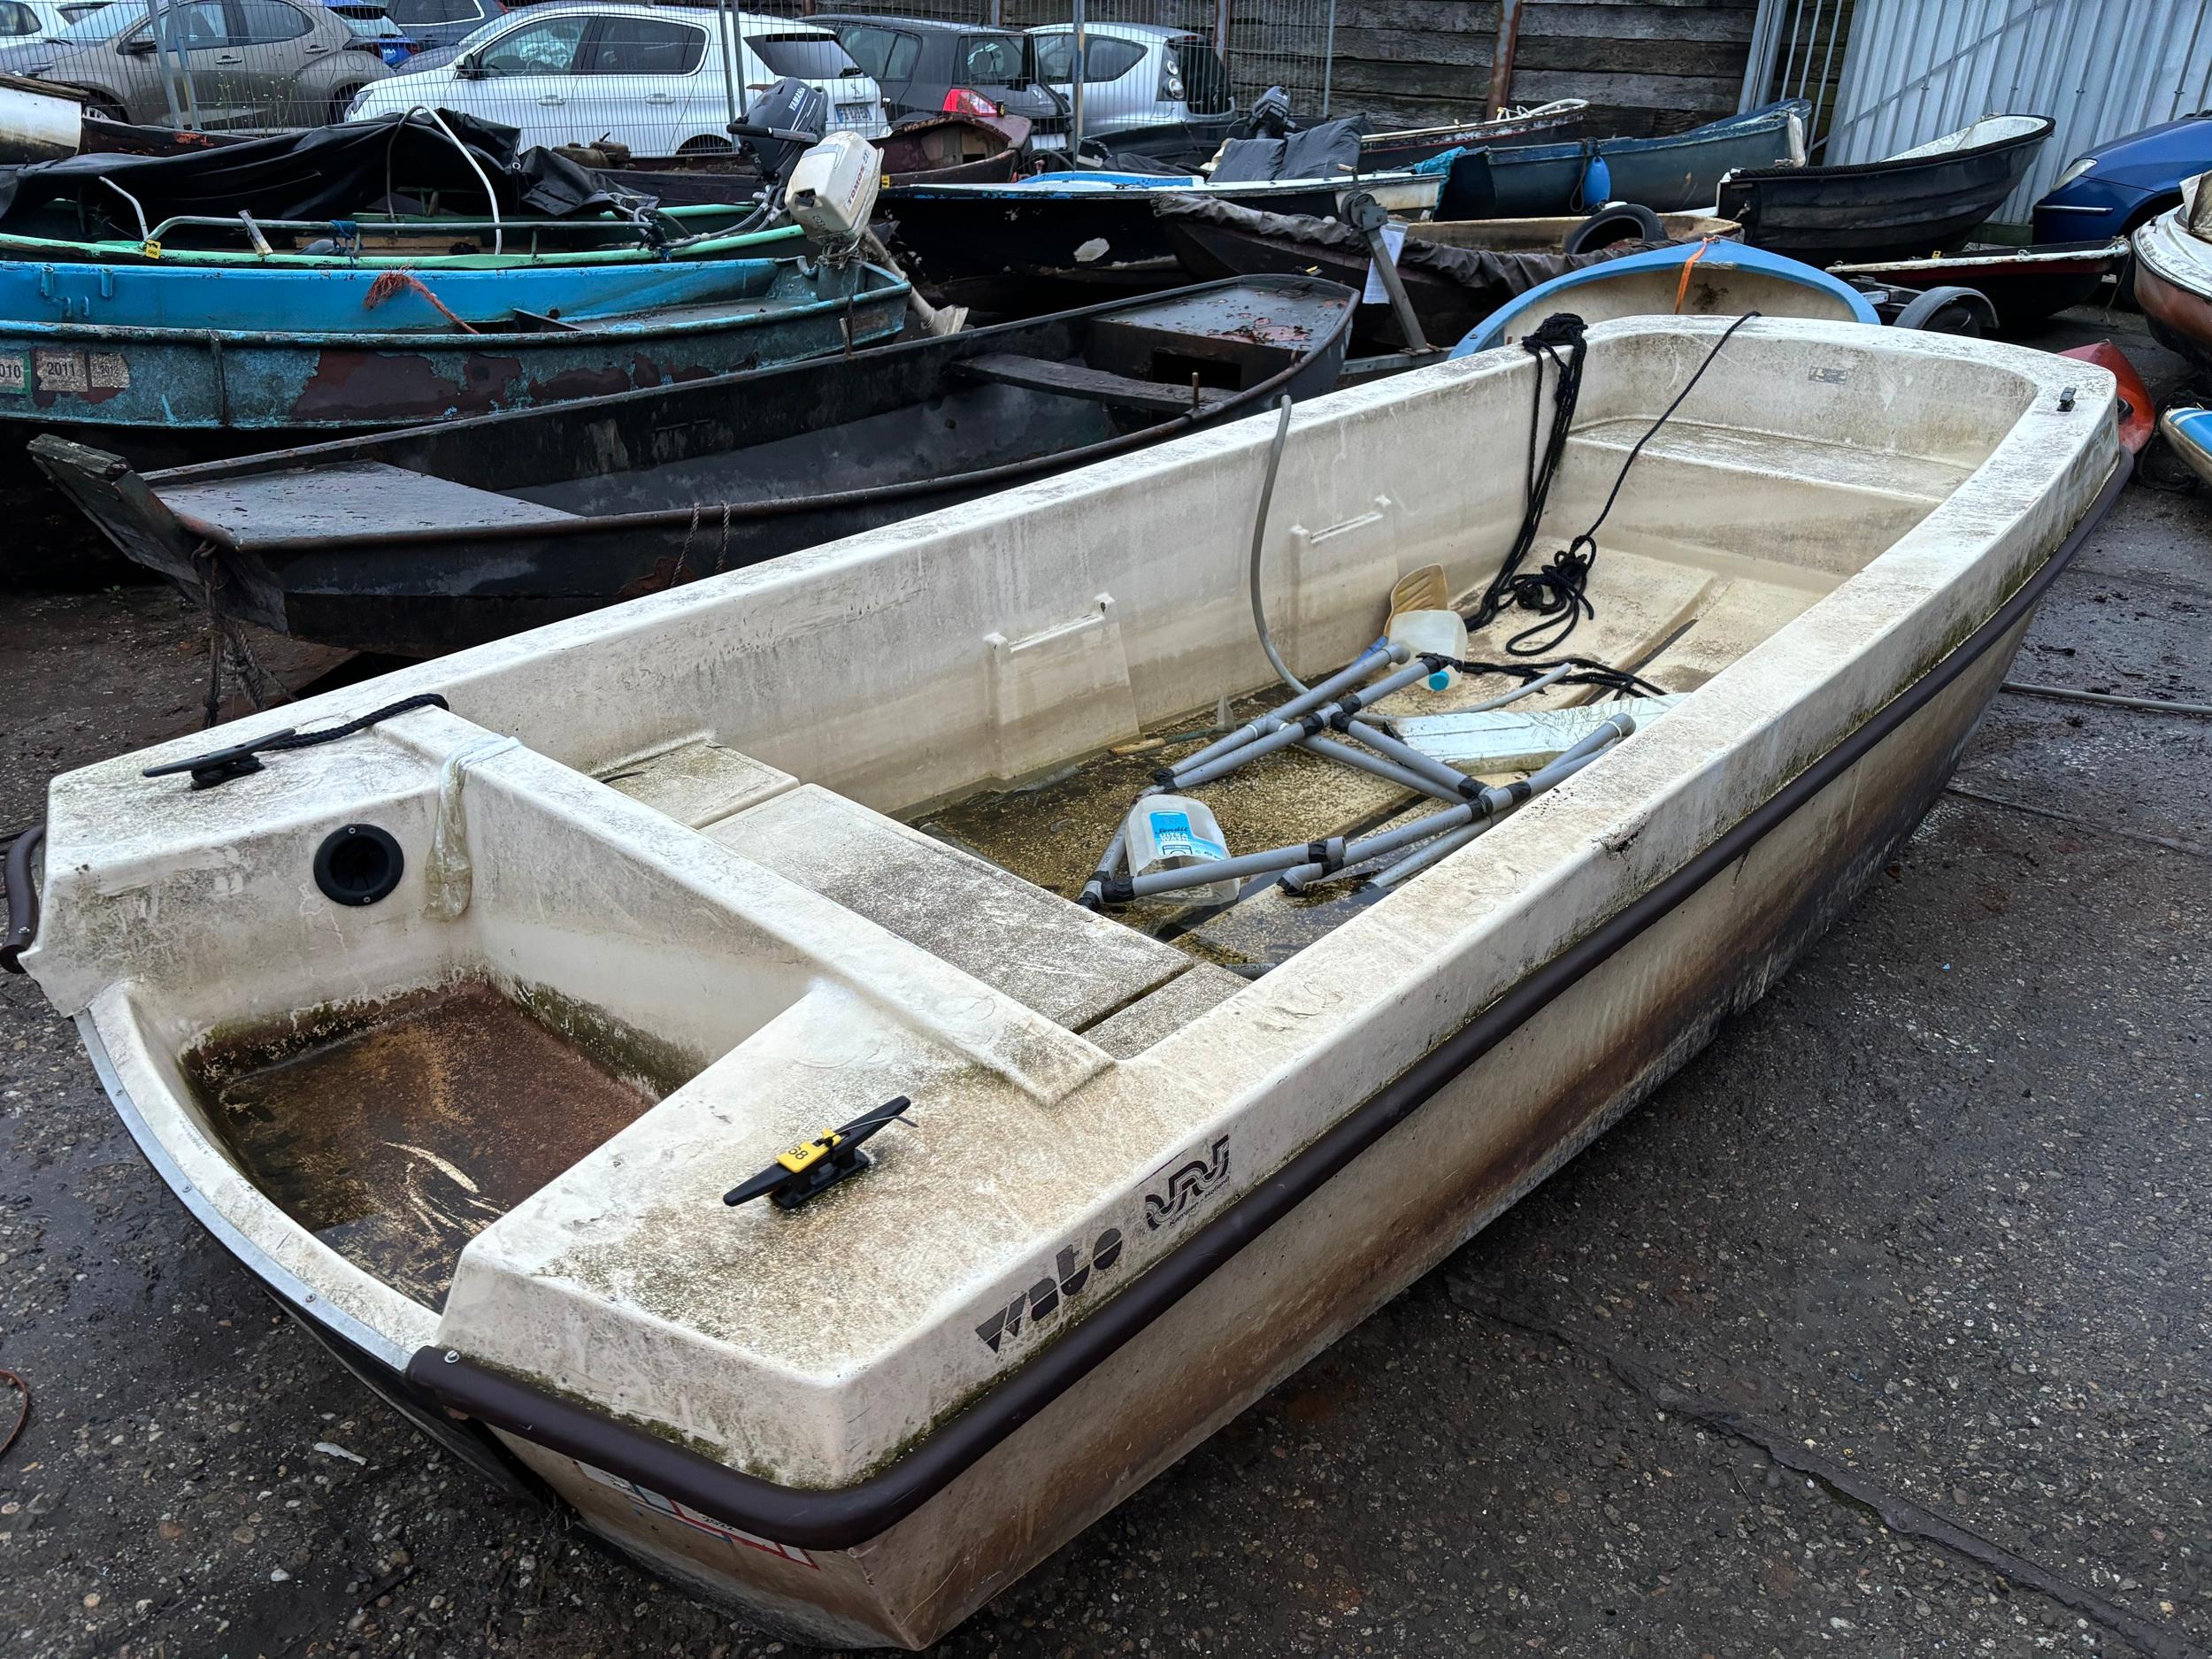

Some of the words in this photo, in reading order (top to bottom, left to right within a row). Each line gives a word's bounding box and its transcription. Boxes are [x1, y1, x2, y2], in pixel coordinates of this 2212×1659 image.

[788, 87, 806, 111] YAMAHA
[848, 165, 864, 204] TOMOS
[46, 361, 75, 376] 2011
[1169, 1202, 1199, 1226] Kampen
[1204, 1175, 1231, 1199] Holland
